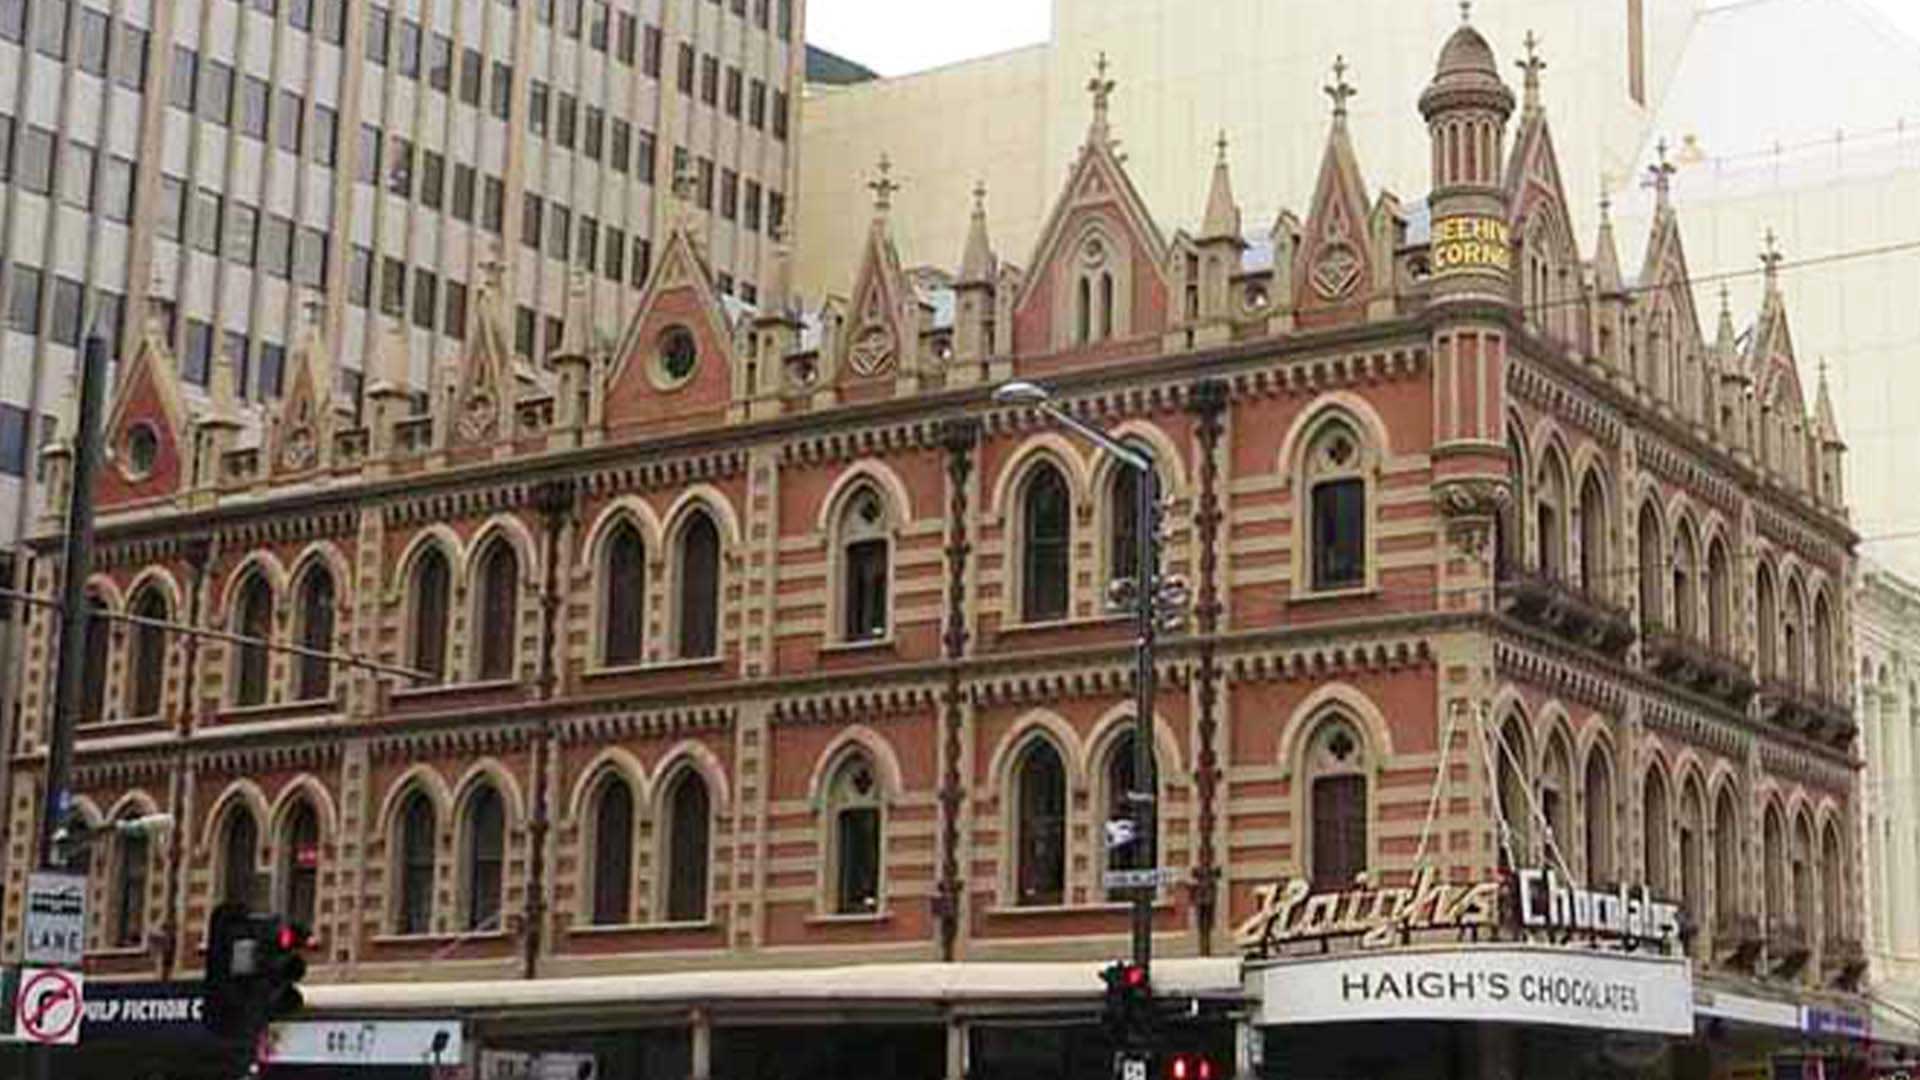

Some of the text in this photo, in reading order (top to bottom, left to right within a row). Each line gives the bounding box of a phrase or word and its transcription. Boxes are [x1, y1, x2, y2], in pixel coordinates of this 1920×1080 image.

[27, 929, 80, 954] LANE
[1341, 971, 1639, 1013] HAIGH'S CHOCOLATES
